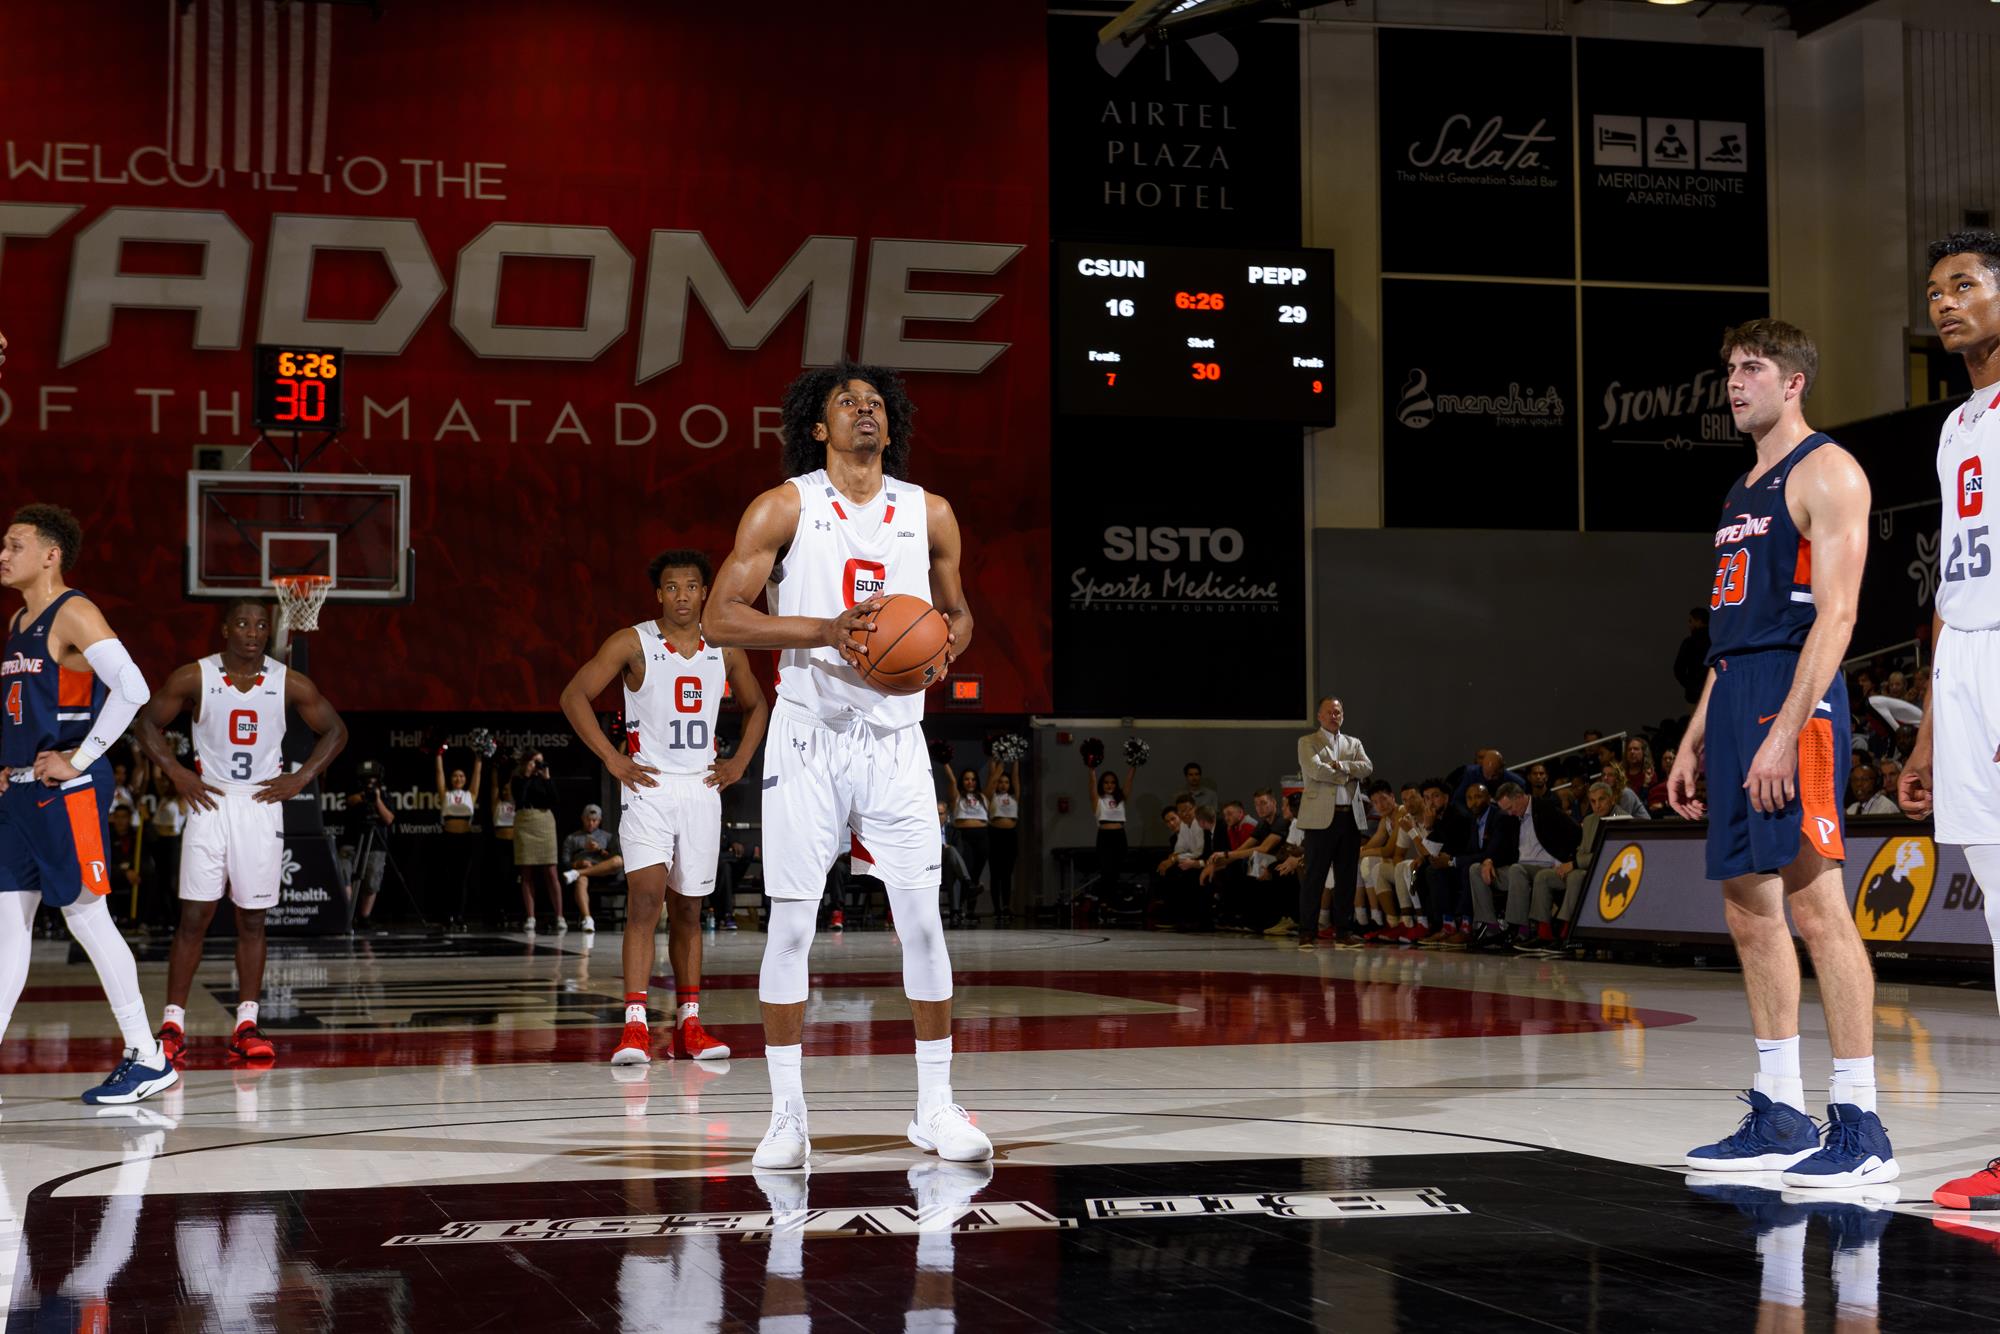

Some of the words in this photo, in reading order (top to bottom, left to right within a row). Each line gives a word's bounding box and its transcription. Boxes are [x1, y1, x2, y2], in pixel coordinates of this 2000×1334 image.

[1101, 100, 1237, 130] AIRTEL
[1408, 113, 1556, 171] Salata
[1107, 140, 1230, 170] PLAZA
[6, 139, 298, 191] WELCO
[400, 158, 507, 199] THE
[1396, 169, 1416, 183] The
[1419, 171, 1444, 184] Next
[1447, 172, 1506, 186] Generation
[1508, 174, 1538, 187] Salad
[1103, 180, 1235, 210] HOTEL
[1597, 171, 1681, 191] MERIDIAN
[1685, 175, 1745, 195] POINTE
[1625, 190, 1717, 208] APARTMENTS
[1077, 258, 1145, 278] CSUN
[1248, 266, 1307, 285] PEPP
[1105, 299, 1135, 317] 16
[1175, 292, 1225, 310] 6:26
[1278, 305, 1308, 323] 29
[278, 352, 337, 379] 6:26
[1192, 363, 1221, 380] 30
[1105, 373, 1117, 386] 7
[1312, 380, 1323, 393] 9
[273, 379, 326, 422] 30
[1436, 381, 1565, 416] menchie's
[363, 394, 784, 450] MATADOR
[1103, 525, 1244, 562] SISTO
[1943, 525, 1992, 582] 25
[855, 579, 885, 592] SUN
[1070, 567, 1152, 606] Sports
[1162, 568, 1278, 600] Medicine
[1170, 603, 1280, 613] FOUNDATION
[5, 680, 23, 725] 4
[683, 690, 702, 699] SUN
[238, 722, 258, 732] SUN
[669, 719, 708, 749] 10
[231, 752, 253, 780] 3
